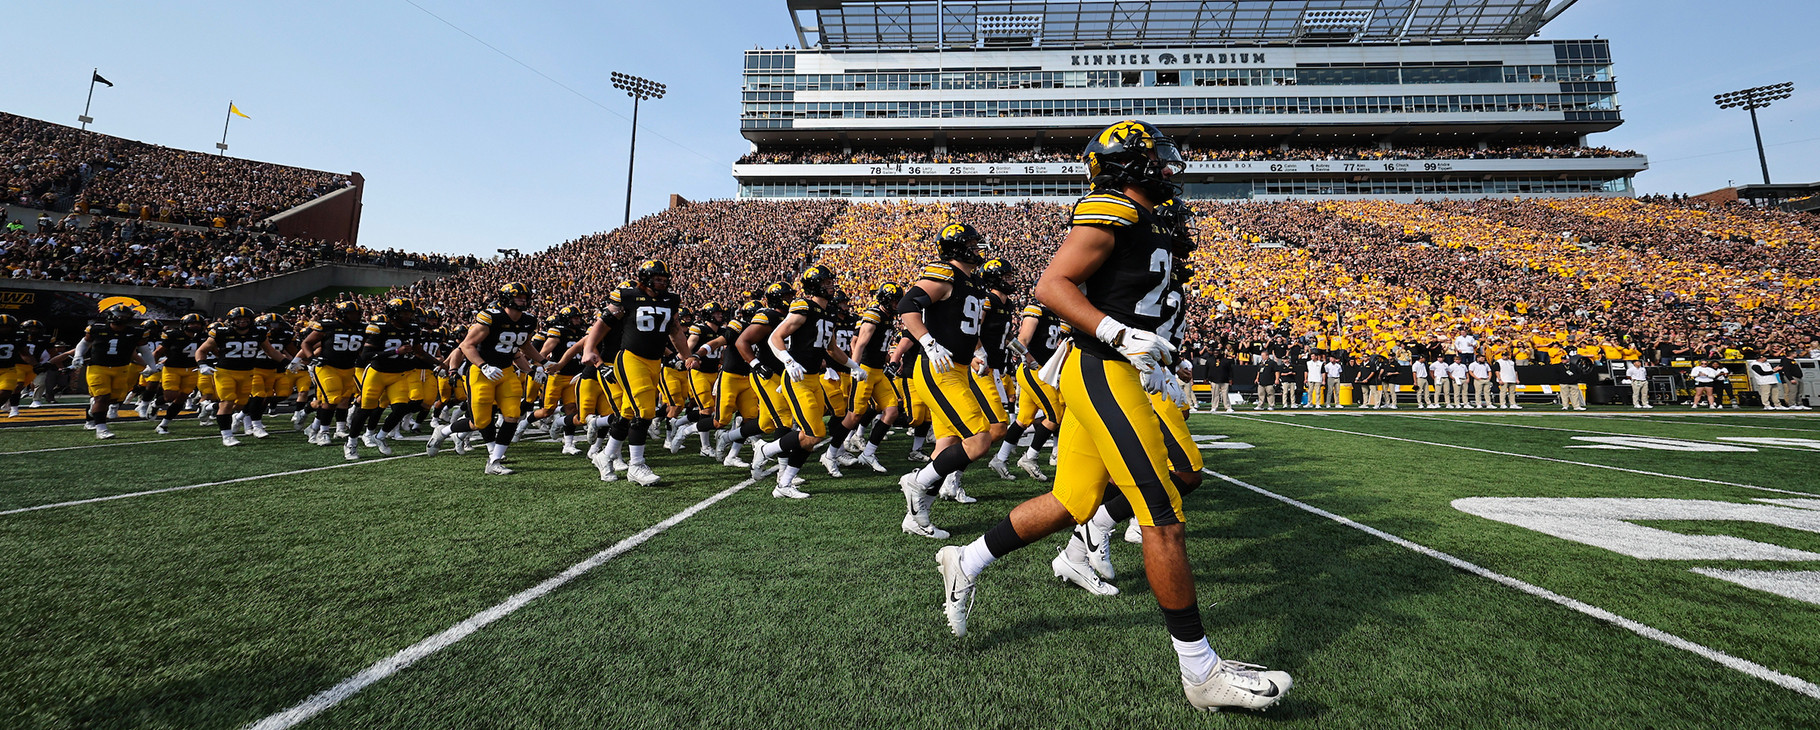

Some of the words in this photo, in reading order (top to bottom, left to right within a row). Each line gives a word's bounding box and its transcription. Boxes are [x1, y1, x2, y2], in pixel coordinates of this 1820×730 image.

[1071, 54, 1150, 66] KINNICK
[1183, 53, 1266, 64] STADIUM
[870, 166, 882, 175] 78
[908, 166, 921, 175] 36
[949, 166, 962, 175] 25
[989, 166, 995, 174] 2
[1024, 166, 1035, 174] 15
[1061, 166, 1074, 174] 24
[1270, 163, 1283, 172] 62
[1310, 163, 1315, 172] 1
[1344, 163, 1355, 171] 77
[1383, 163, 1395, 171] 16
[1424, 163, 1437, 171] 99
[1134, 247, 1173, 318] 2
[636, 306, 672, 333] 67
[813, 318, 835, 348] 15
[1045, 325, 1062, 350] 8
[107, 338, 119, 355] 1
[333, 333, 364, 352] 56
[182, 342, 198, 358] 4
[225, 341, 259, 359] 26
